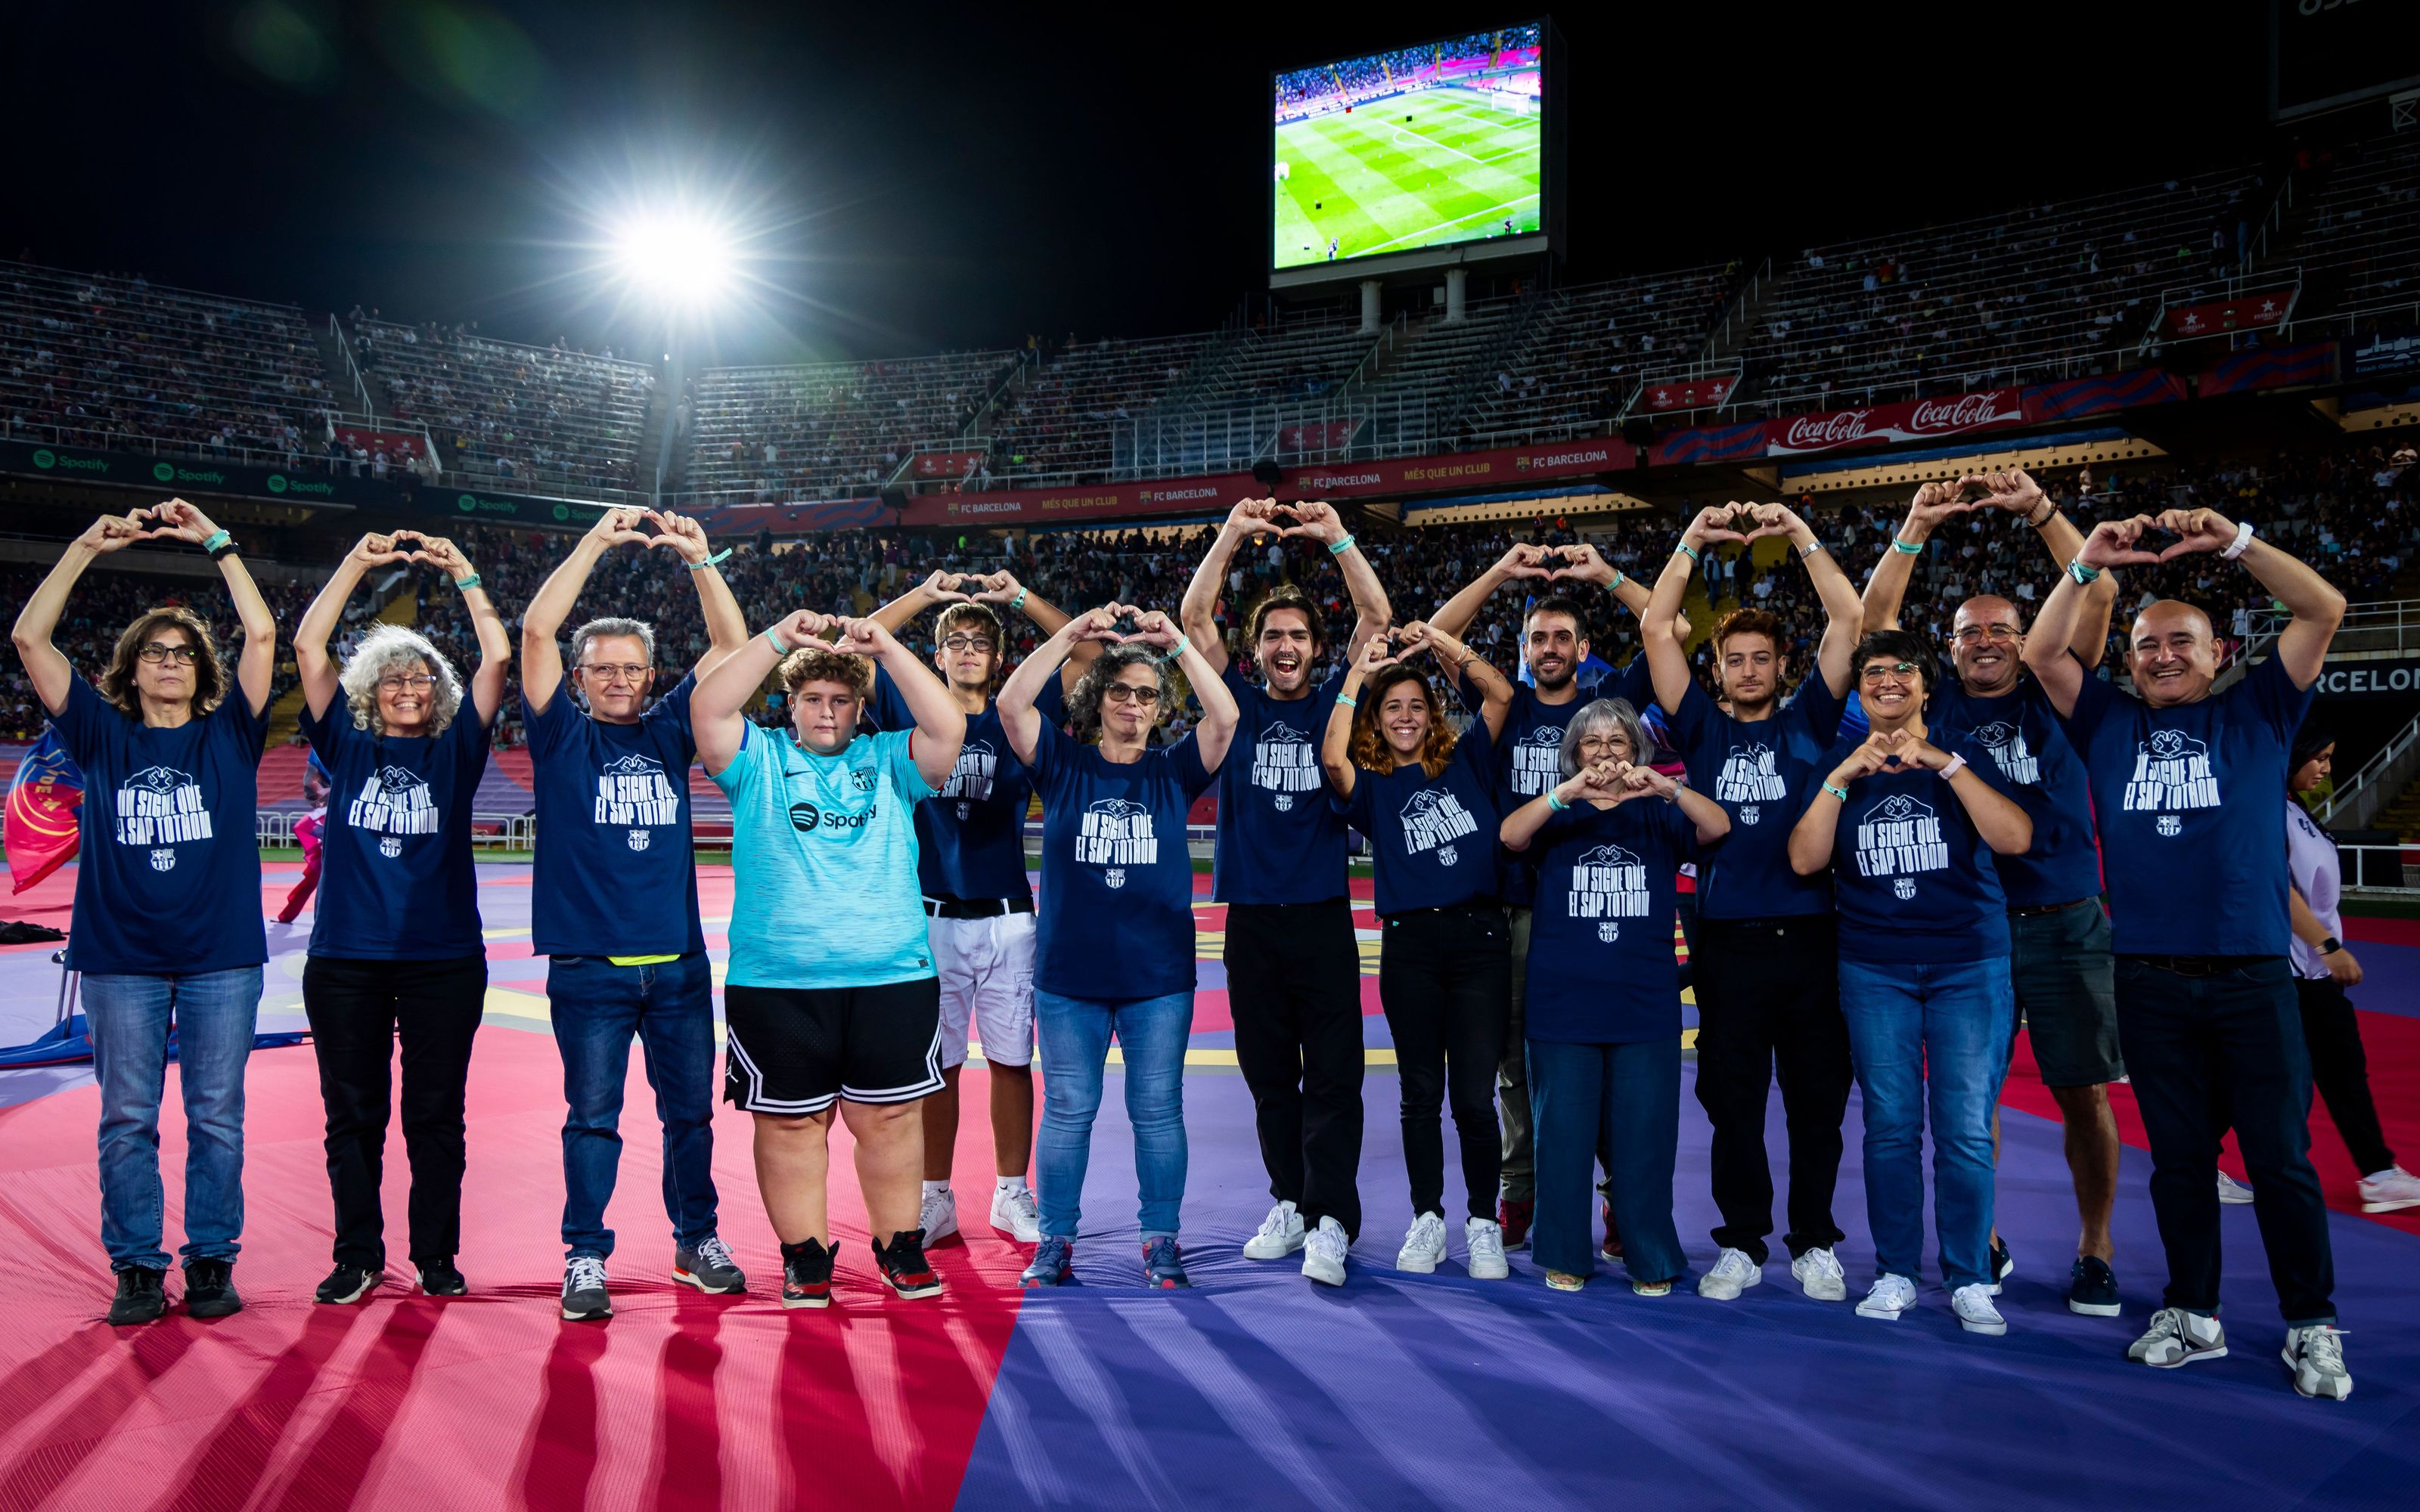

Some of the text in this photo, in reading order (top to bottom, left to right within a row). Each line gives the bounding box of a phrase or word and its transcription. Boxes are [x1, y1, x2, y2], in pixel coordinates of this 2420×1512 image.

[1912, 391, 2004, 431] Coca-Cola
[1788, 409, 1873, 445] Coca-Cola
[59, 456, 110, 472] Spotify
[1404, 463, 1490, 481] MÉS QUE UN CLUB
[1533, 450, 1608, 468] FC BARCELONA
[178, 469, 225, 485] Spotify
[290, 480, 334, 495] Spotify
[1314, 478, 1324, 488] FC
[479, 500, 517, 512] Spotify
[961, 502, 1022, 513] FC BARCELONA
[1042, 496, 1118, 510] MÉS QUE UN CLUB
[1154, 488, 1218, 501] FC BARCELONA
[1256, 743, 1269, 767] UN
[1270, 743, 1298, 767] SIGNE
[1513, 745, 1560, 772] UN SIGNE
[1261, 767, 1282, 791] SAP
[1283, 765, 1322, 792] TOTHOM
[1511, 769, 1519, 792] EL
[1520, 770, 1540, 795] SAP
[2133, 754, 2212, 785] UN SIGNE QUE
[359, 776, 383, 803] UN
[409, 783, 433, 813] QUE
[599, 776, 615, 802] UN
[617, 776, 654, 803] SIGNE
[942, 776, 963, 798] SAP
[1724, 782, 1749, 802] SAP
[2124, 777, 2221, 810] EL SAP TOTHOM
[117, 785, 204, 817] UN SIGNE QUE
[594, 796, 607, 823] EL
[610, 801, 635, 825] SAP
[1413, 804, 1445, 832] SIGNE
[1438, 794, 1464, 818] QUE
[127, 816, 154, 845] SAP
[156, 810, 213, 844] TOTHOM
[348, 799, 438, 834] EL SAP TOTHOM
[824, 804, 876, 829] Spotiy
[1081, 813, 1154, 841] UN SIGNE QUE
[1413, 830, 1437, 851] SAP
[1434, 810, 1478, 844] TOTHOM
[1858, 817, 1942, 850] UN SIGNE QUE
[1075, 835, 1158, 864] EL SAP TOTHOM
[1855, 843, 1949, 876] EL SAP TOTHOM
[1573, 865, 1646, 894] UN SIGNE QUE
[1568, 891, 1650, 917] EL SAP TOTHOM
